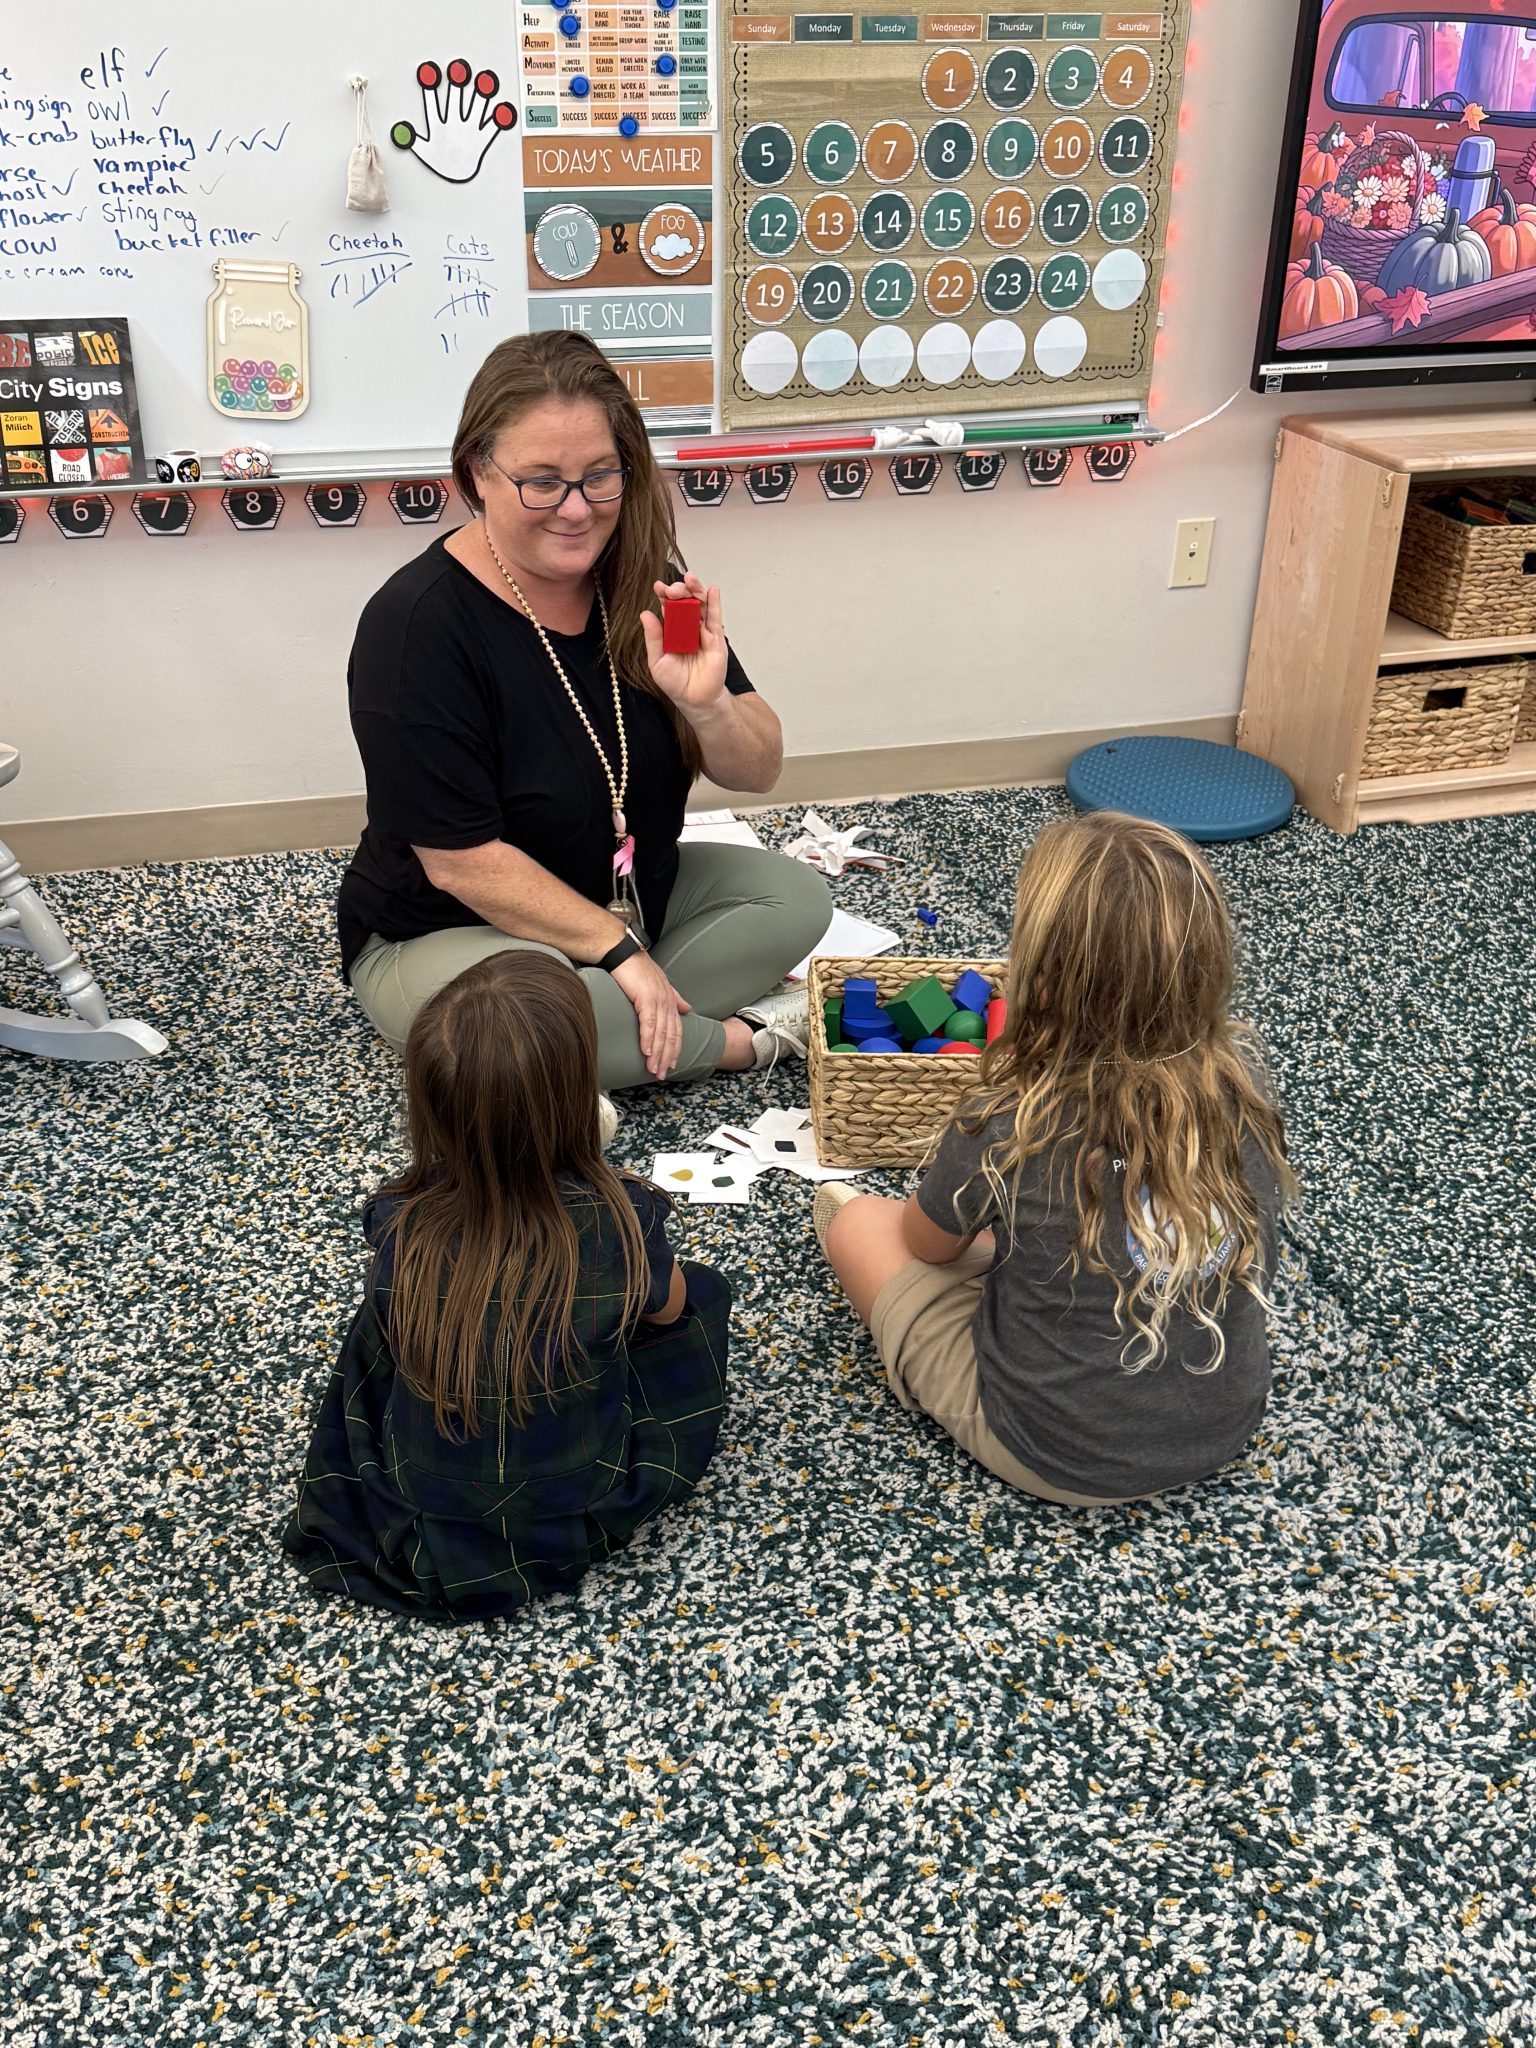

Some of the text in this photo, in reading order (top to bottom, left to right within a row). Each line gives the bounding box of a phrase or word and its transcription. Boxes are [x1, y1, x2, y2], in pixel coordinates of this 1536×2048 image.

[594, 11, 609, 19] RAISE
[653, 10, 670, 18] RAISE
[653, 21, 671, 29] HAND
[684, 9, 702, 19] RAISE
[684, 21, 702, 29] HAND
[747, 23, 777, 35] Sunday
[808, 23, 842, 35] Monday
[874, 23, 907, 35] Tuesday
[931, 22, 976, 33] Wednesday
[998, 22, 1034, 33] Thursday
[1062, 21, 1086, 32] Friday
[1116, 21, 1151, 33] Saturday
[682, 37, 706, 46] TESTING
[80, 47, 125, 90] elf
[524, 57, 556, 69] MOVEMENT
[943, 68, 956, 92] 1
[1002, 67, 1017, 92] 2
[1064, 66, 1080, 90] 3
[1118, 65, 1133, 89] 4
[528, 109, 552, 123] SUCCESS
[562, 112, 588, 121] SUCCESS
[594, 112, 618, 121] SUCCESS
[651, 112, 677, 121] SUCCESS
[682, 111, 707, 120] SUCCESS
[760, 142, 775, 167] 5
[824, 140, 839, 165] 6
[883, 140, 898, 164] 7
[941, 139, 956, 163] 8
[1004, 137, 1018, 161] 9
[1053, 135, 1082, 159] 10
[1112, 134, 1139, 158] 11
[92, 155, 192, 182] vampire
[533, 147, 702, 175] TODAY'S WEATHER
[660, 214, 686, 231] FOG
[816, 212, 844, 236] 13
[873, 209, 902, 235] 14
[934, 208, 962, 232] 15
[993, 206, 1022, 229] 16
[1053, 203, 1081, 228] 17
[1109, 201, 1136, 226] 18
[552, 221, 578, 242] COLD
[759, 213, 788, 238] 12
[328, 232, 403, 251] Cheetah
[446, 234, 491, 257] Cats
[610, 222, 629, 254] &
[812, 280, 842, 306] 20
[874, 278, 903, 302] 21
[935, 275, 964, 299] 22
[994, 273, 1022, 296] 23
[1050, 269, 1079, 294] 24
[755, 283, 785, 308] 19
[559, 301, 685, 332] THE SEASON
[37, 348, 76, 361] POLIC
[0, 377, 123, 403] City Signs
[4, 414, 28, 423] Zoran
[5, 423, 33, 432] Milich
[967, 454, 993, 477] 18
[1033, 450, 1059, 472] 19
[1096, 444, 1124, 466] 20
[62, 463, 81, 473] ROAD
[757, 465, 784, 488] 15
[832, 462, 860, 484] 16
[902, 457, 930, 479] 17
[692, 469, 720, 491] 14
[156, 496, 171, 519] 7
[245, 490, 262, 514] 8
[326, 488, 343, 510] 9
[403, 485, 435, 508] 10
[71, 499, 90, 522] 6
